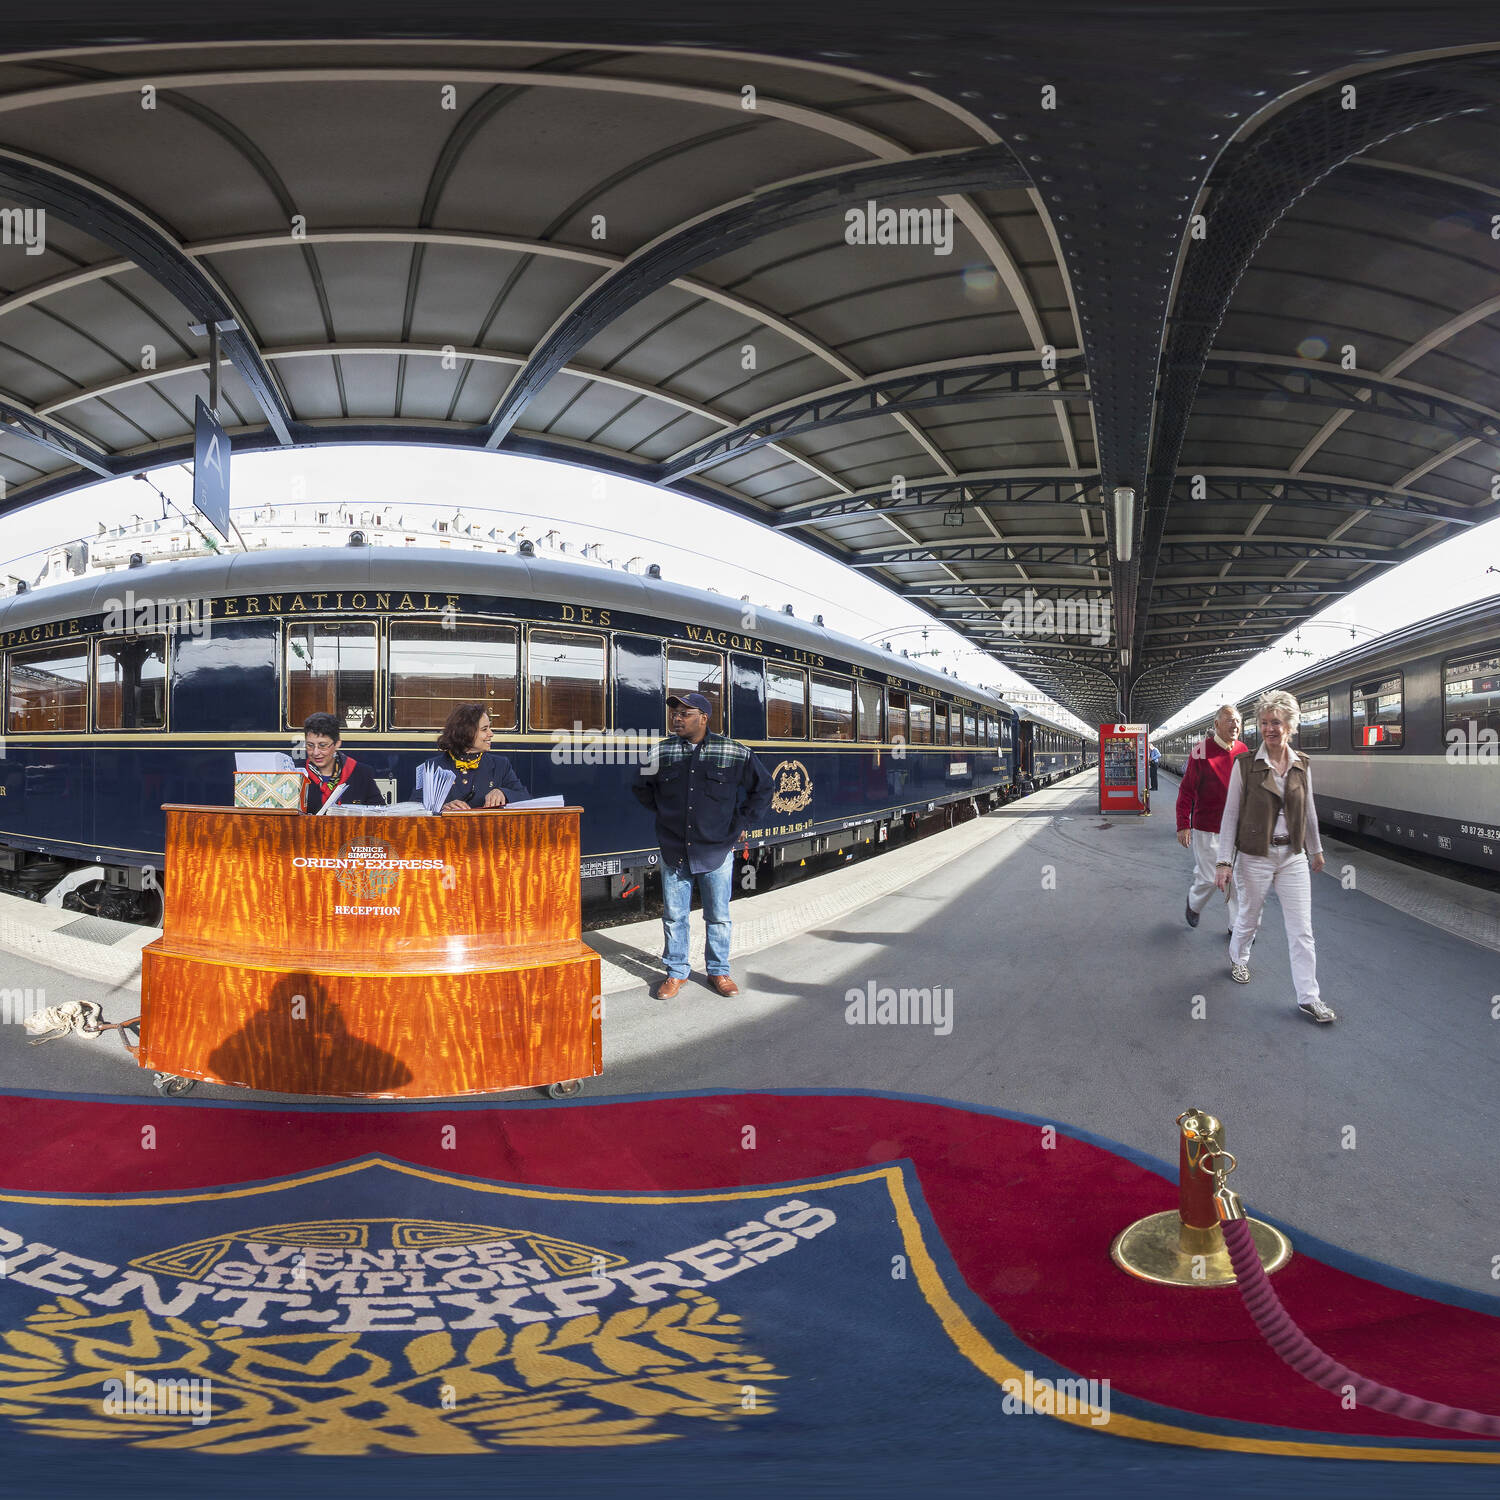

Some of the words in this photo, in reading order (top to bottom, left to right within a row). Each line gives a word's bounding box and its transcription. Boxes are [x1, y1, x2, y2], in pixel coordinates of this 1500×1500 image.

[204, 433, 225, 489] A
[171, 593, 463, 619] INTERNATIONALE
[561, 605, 612, 626] DES
[686, 625, 763, 653] WAGONS
[793, 650, 824, 667] LITS
[334, 905, 401, 916] RECEPTION
[244, 1241, 523, 1272] VENICE
[203, 1259, 550, 1294] SIMPLON
